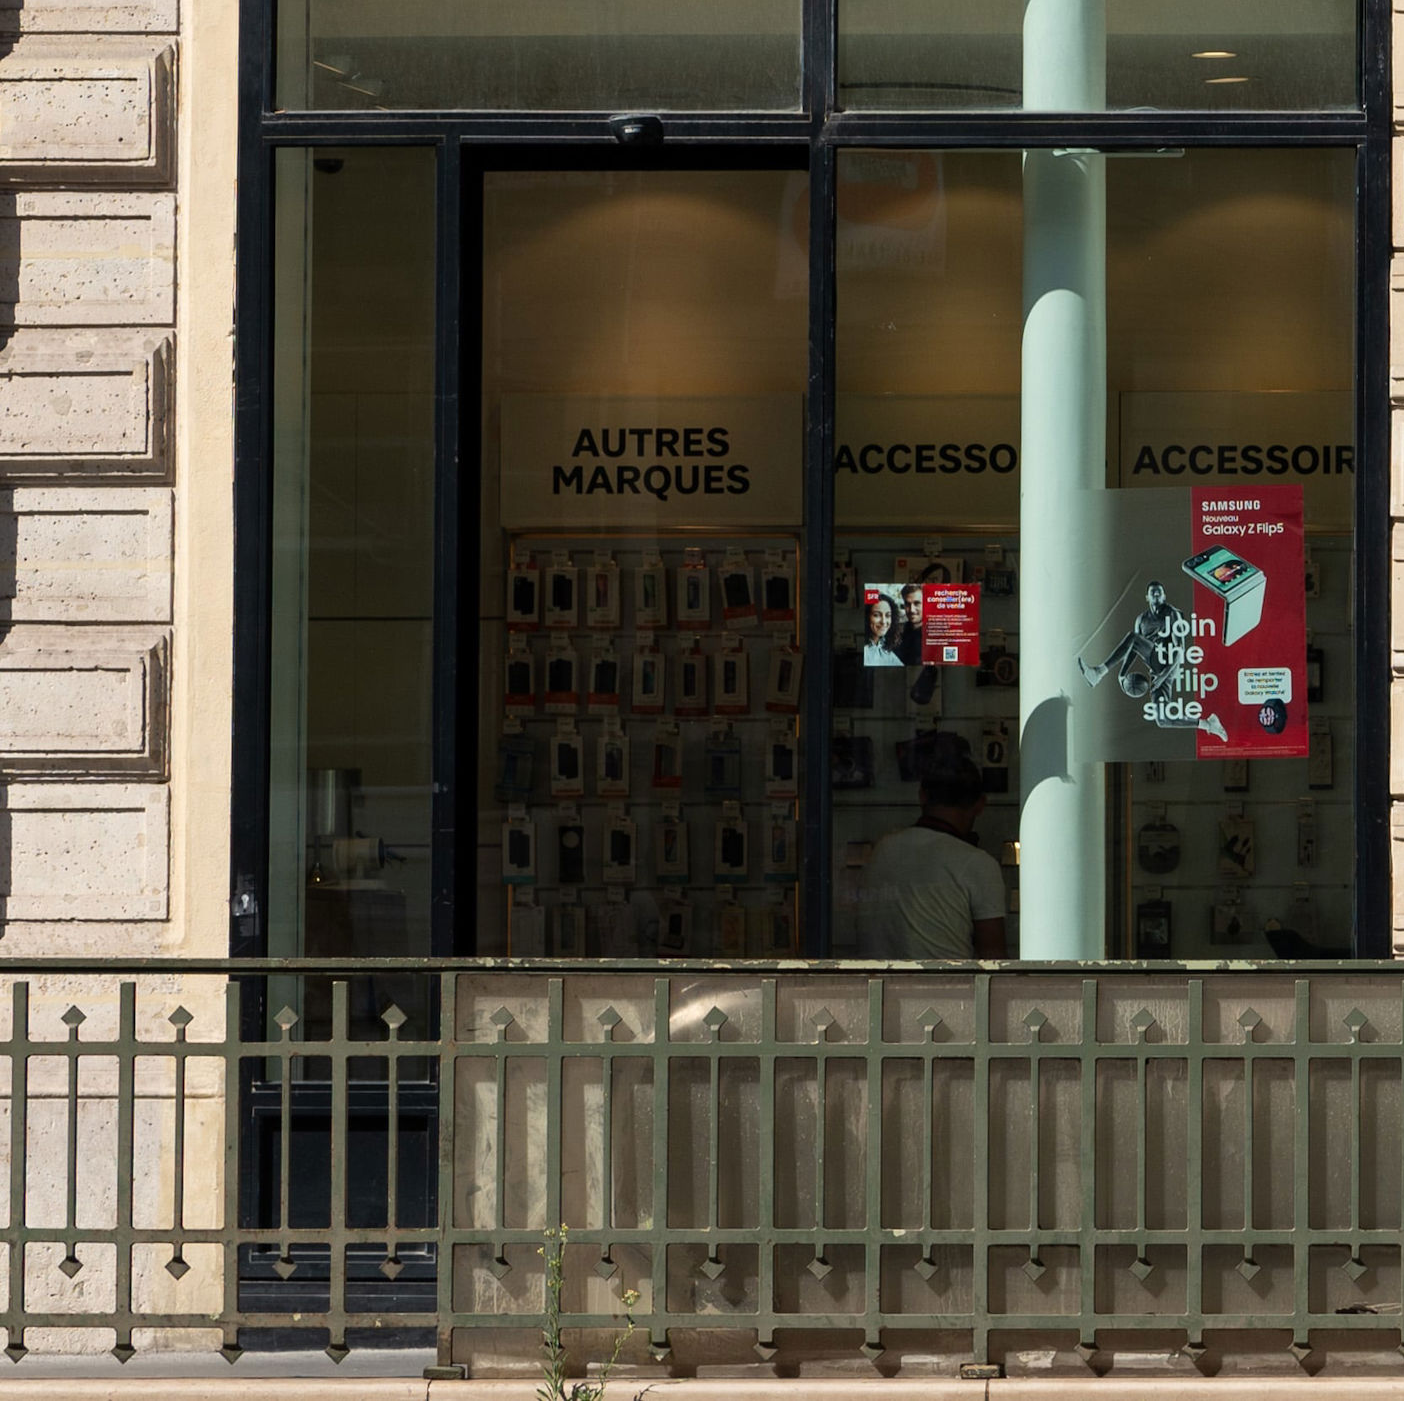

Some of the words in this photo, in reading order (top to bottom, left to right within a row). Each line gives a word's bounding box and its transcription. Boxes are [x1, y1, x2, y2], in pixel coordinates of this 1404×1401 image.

[571, 427, 730, 458] AUTRES
[834, 443, 1018, 474] ACCESSO
[1133, 444, 1354, 474] ACCESSOIR
[552, 464, 750, 501] MARQUES
[1201, 500, 1261, 512] SAMSUNG
[1202, 514, 1239, 523] Nouveau
[1202, 524, 1247, 537] Galaxy
[1248, 524, 1255, 534] Z
[1256, 522, 1284, 537] Flip5
[934, 589, 968, 597] recherche
[1157, 612, 1217, 639] Join
[1155, 640, 1204, 666] the
[1174, 667, 1219, 697] flip
[1142, 696, 1203, 722] side
